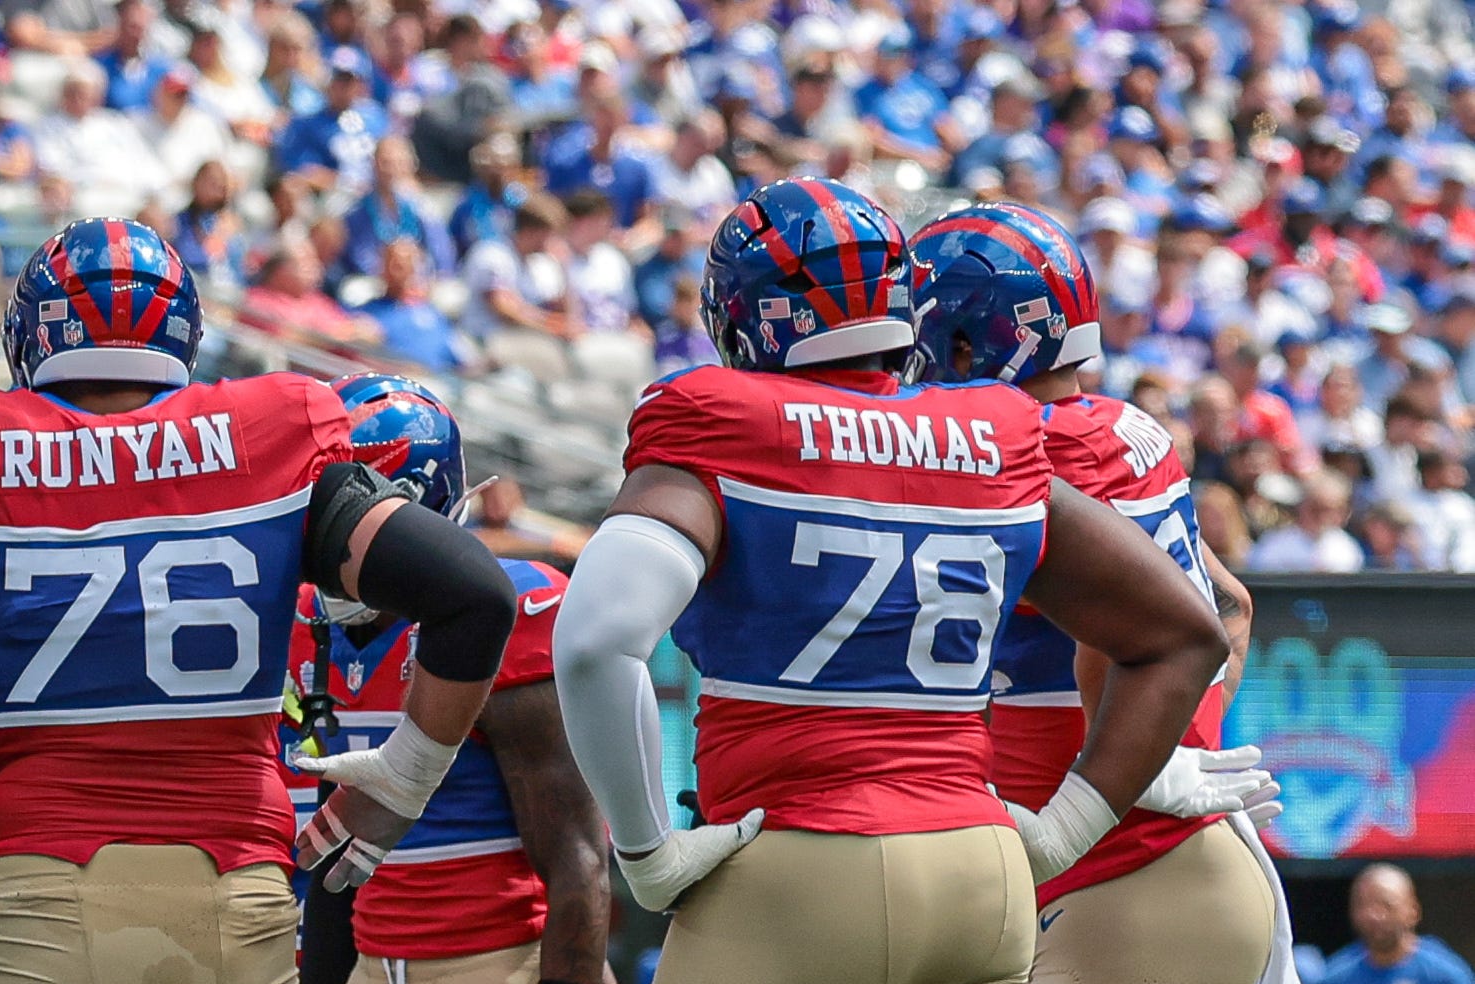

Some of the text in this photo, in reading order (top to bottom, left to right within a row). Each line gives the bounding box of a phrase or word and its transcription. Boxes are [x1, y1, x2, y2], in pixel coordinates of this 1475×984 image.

[0, 413, 236, 488] RUNYAN
[784, 403, 1001, 477] THOMAS
[5, 536, 259, 703] 76
[779, 521, 1005, 689] 78
